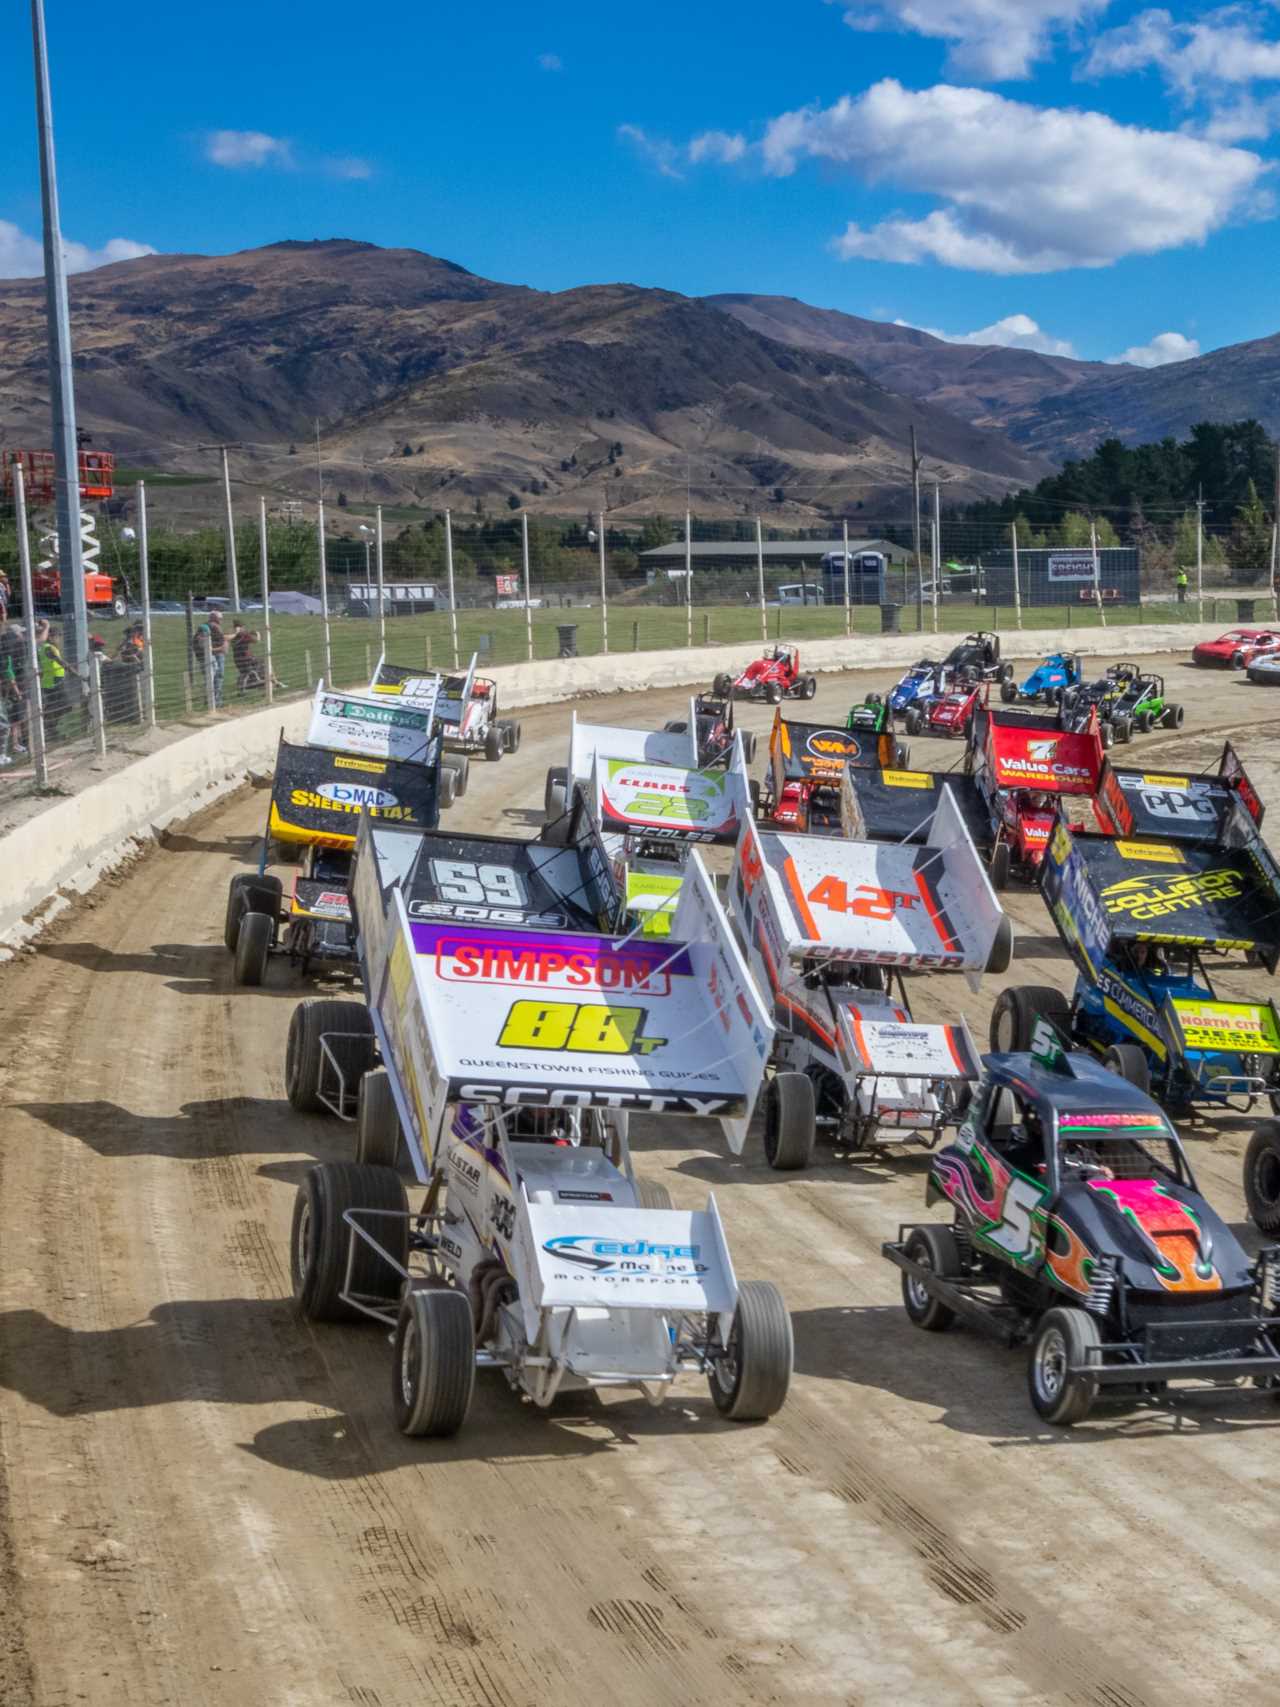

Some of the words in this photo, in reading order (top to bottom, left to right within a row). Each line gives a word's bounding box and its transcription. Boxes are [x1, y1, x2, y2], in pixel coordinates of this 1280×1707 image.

[1000, 758, 1048, 773] Value
[1052, 763, 1090, 777] Cars
[1001, 769, 1093, 785] WAREHOUSE
[1145, 791, 1213, 815] PPG
[1025, 828, 1049, 838] Valu
[430, 857, 528, 907] 59
[1104, 870, 1243, 914] COLLISION
[1130, 885, 1242, 920] CENTRE
[453, 945, 651, 991] SIMPSON
[805, 945, 965, 968] CHESTER
[1181, 1016, 1231, 1028] NORTH
[1235, 1020, 1264, 1031] CITY
[1184, 1028, 1274, 1042] DIESEL
[458, 1058, 583, 1073] QUEENSTOWN
[588, 1066, 655, 1078] FISHING
[659, 1070, 721, 1082] GUIDES
[620, 1261, 687, 1272] Mane
